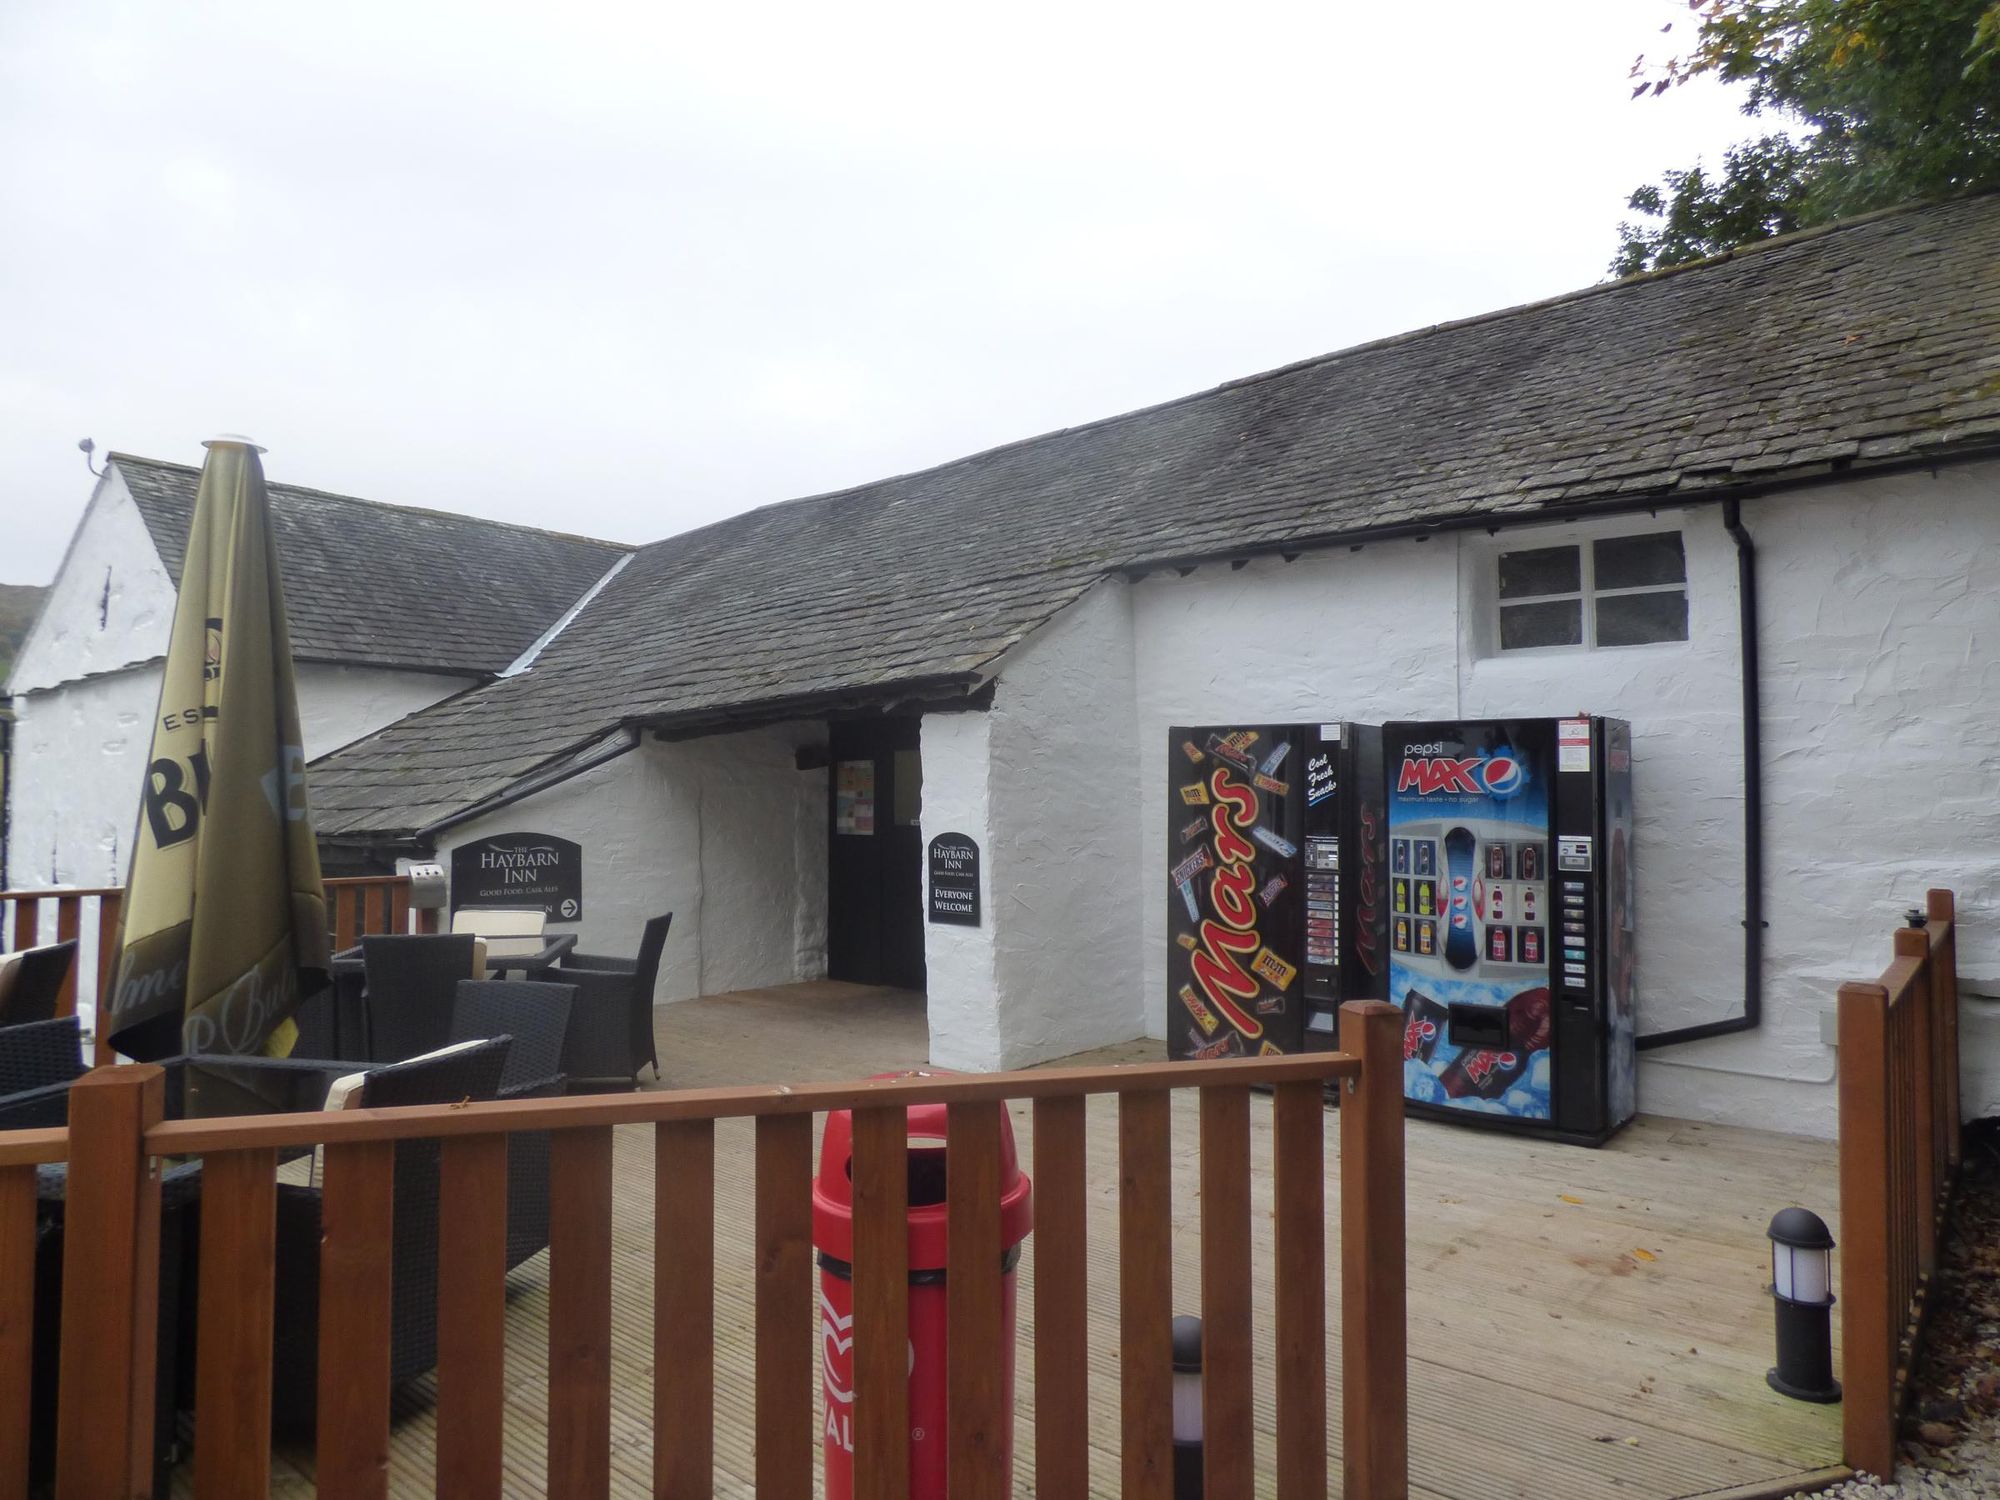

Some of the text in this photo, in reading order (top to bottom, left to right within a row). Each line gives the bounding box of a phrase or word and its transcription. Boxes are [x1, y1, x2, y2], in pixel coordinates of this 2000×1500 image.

[1404, 741, 1443, 756] pepsi
[1308, 753, 1328, 771] Cool
[1308, 764, 1334, 787] Fresh
[1397, 757, 1489, 796] MAX
[1308, 780, 1337, 801] Snacks
[1425, 795, 1442, 803] taste
[1459, 796, 1480, 805] sugar
[481, 852, 559, 869] HAYBARN
[933, 848, 974, 860] HAYBARN
[945, 860, 962, 869] INN
[504, 869, 537, 883] INN
[935, 888, 974, 901] EVERYONE
[935, 900, 973, 913] WELCOME
[1190, 767, 1264, 1040] Mars
